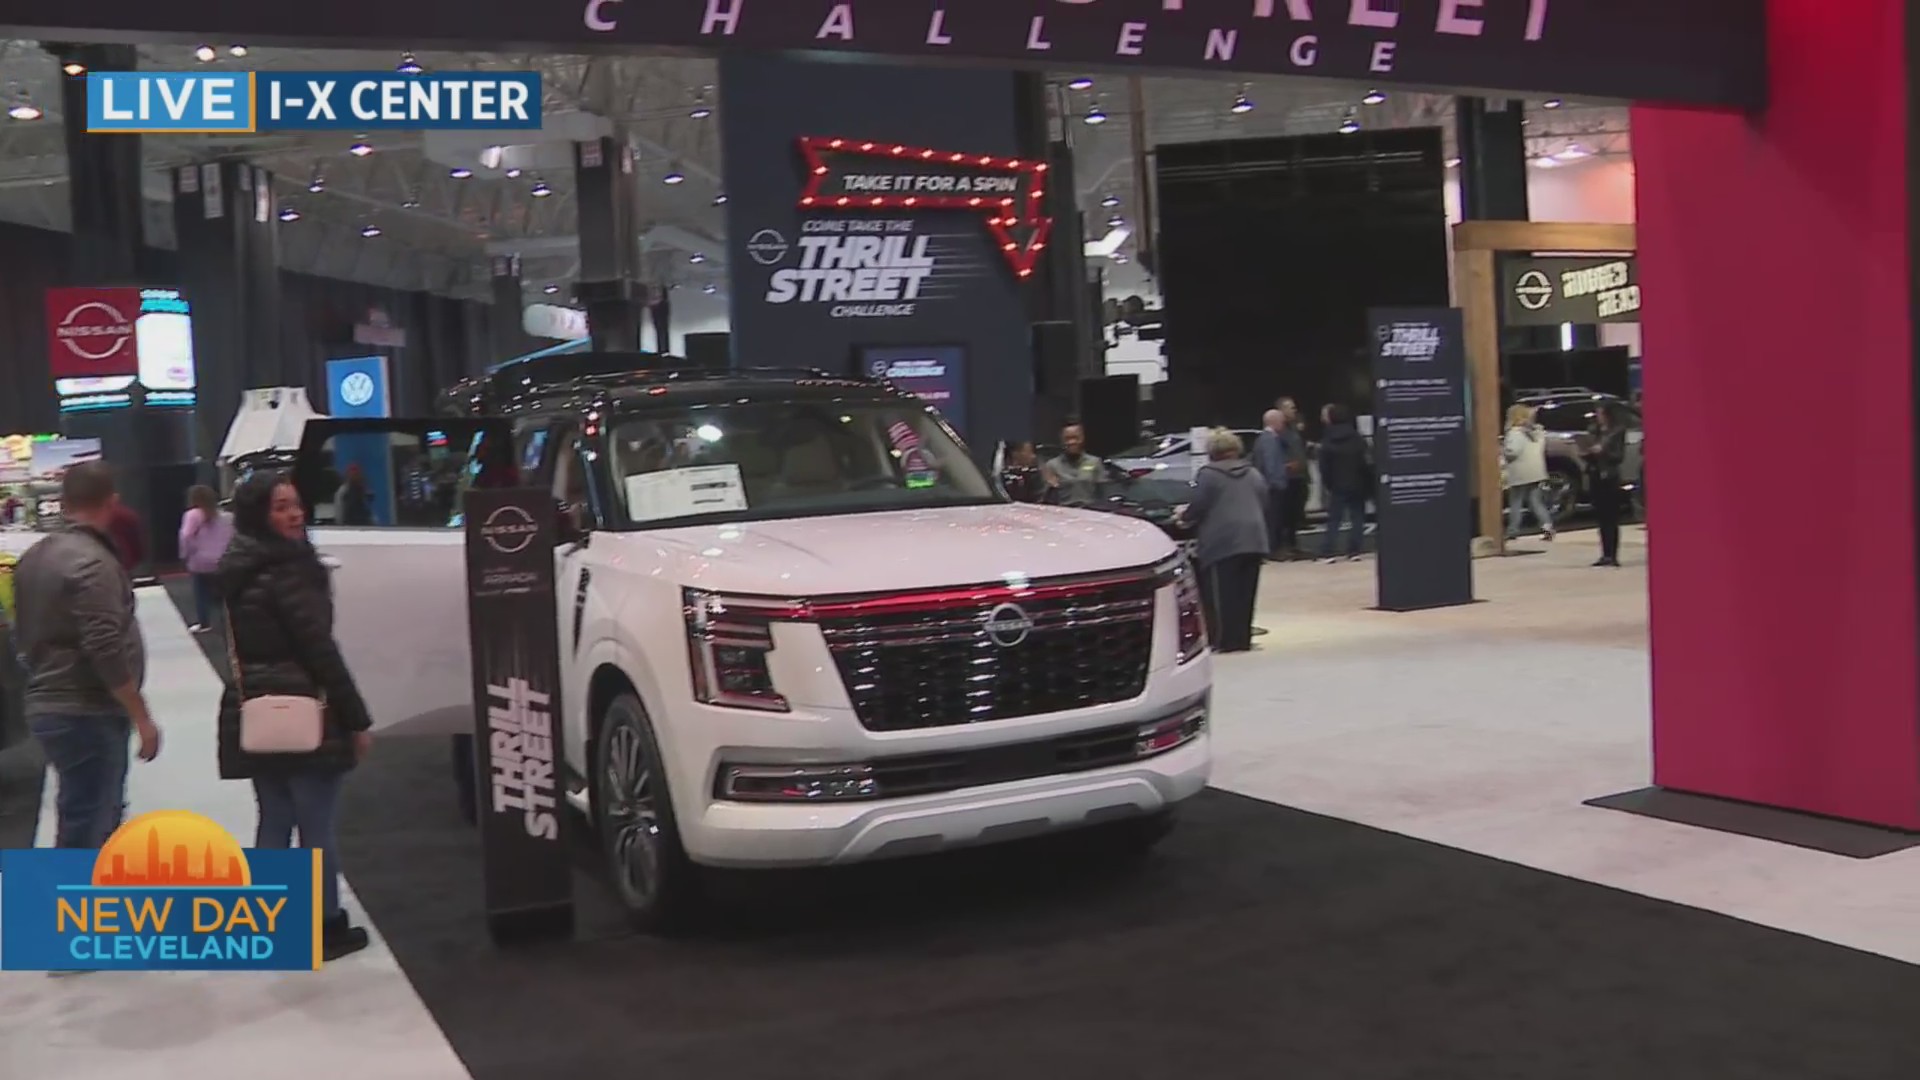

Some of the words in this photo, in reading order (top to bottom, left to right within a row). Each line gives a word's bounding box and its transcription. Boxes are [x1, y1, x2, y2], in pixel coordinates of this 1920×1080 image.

[583, 0, 1397, 72] CHALLENGE
[843, 175, 892, 191] TAKE
[893, 175, 913, 190] IT
[914, 175, 953, 190] FOR
[954, 177, 971, 191] A
[973, 177, 1018, 191] SPIN
[797, 235, 935, 268] THRILL
[766, 269, 932, 302] STREET
[831, 304, 915, 317] CHALLENGE
[57, 325, 132, 336] NISSAN
[487, 678, 525, 812] THRILL
[518, 678, 558, 839] STREET
